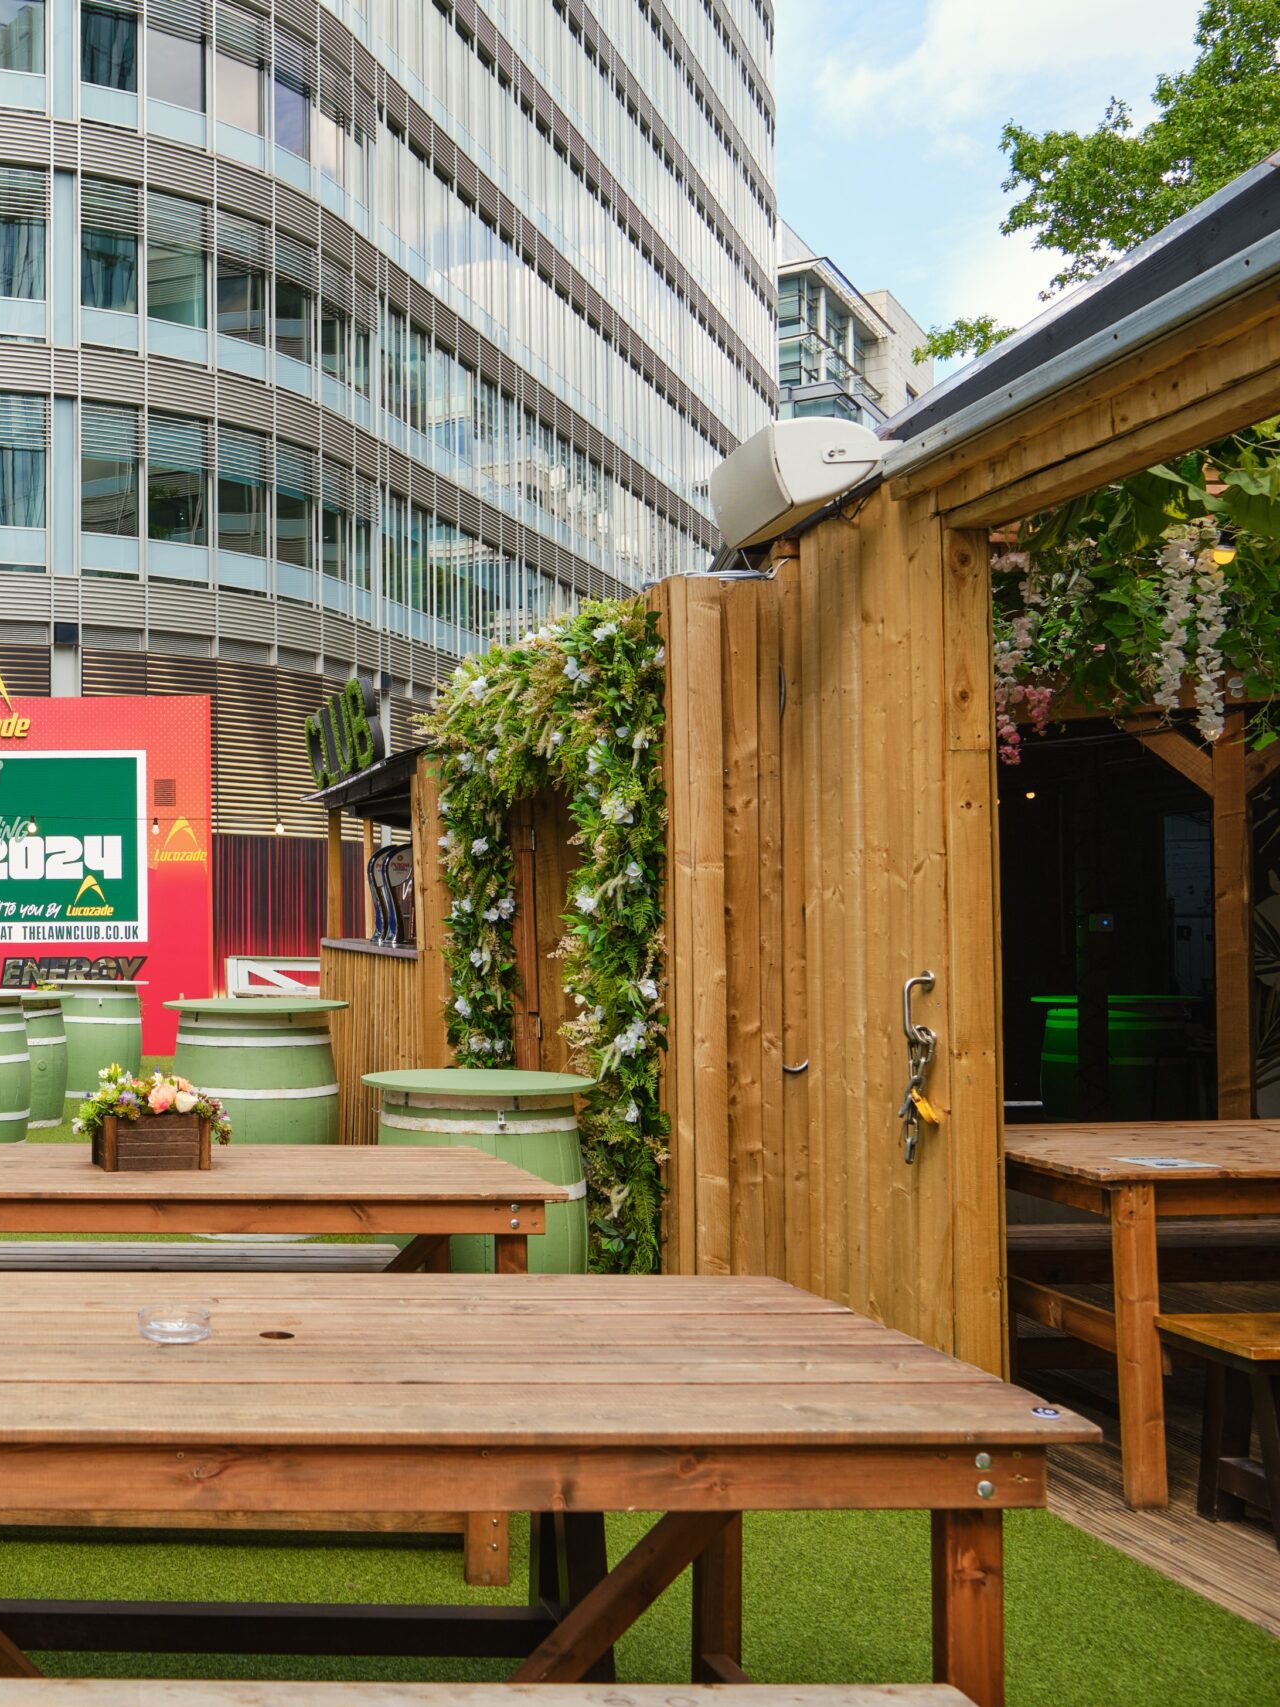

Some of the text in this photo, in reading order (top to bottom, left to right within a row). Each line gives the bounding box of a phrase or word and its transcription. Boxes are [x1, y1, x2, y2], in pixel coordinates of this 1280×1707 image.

[304, 677, 385, 791] CLUB
[154, 848, 208, 862] Lucozade
[4, 902, 17, 917] TO
[20, 904, 45, 919] YOU
[45, 903, 63, 918] BY
[66, 904, 114, 917] Lucozade
[0, 926, 13, 941] AT
[22, 925, 139, 941] THELAWNCLUB.CO.UK
[1, 956, 148, 988] ENERGY
